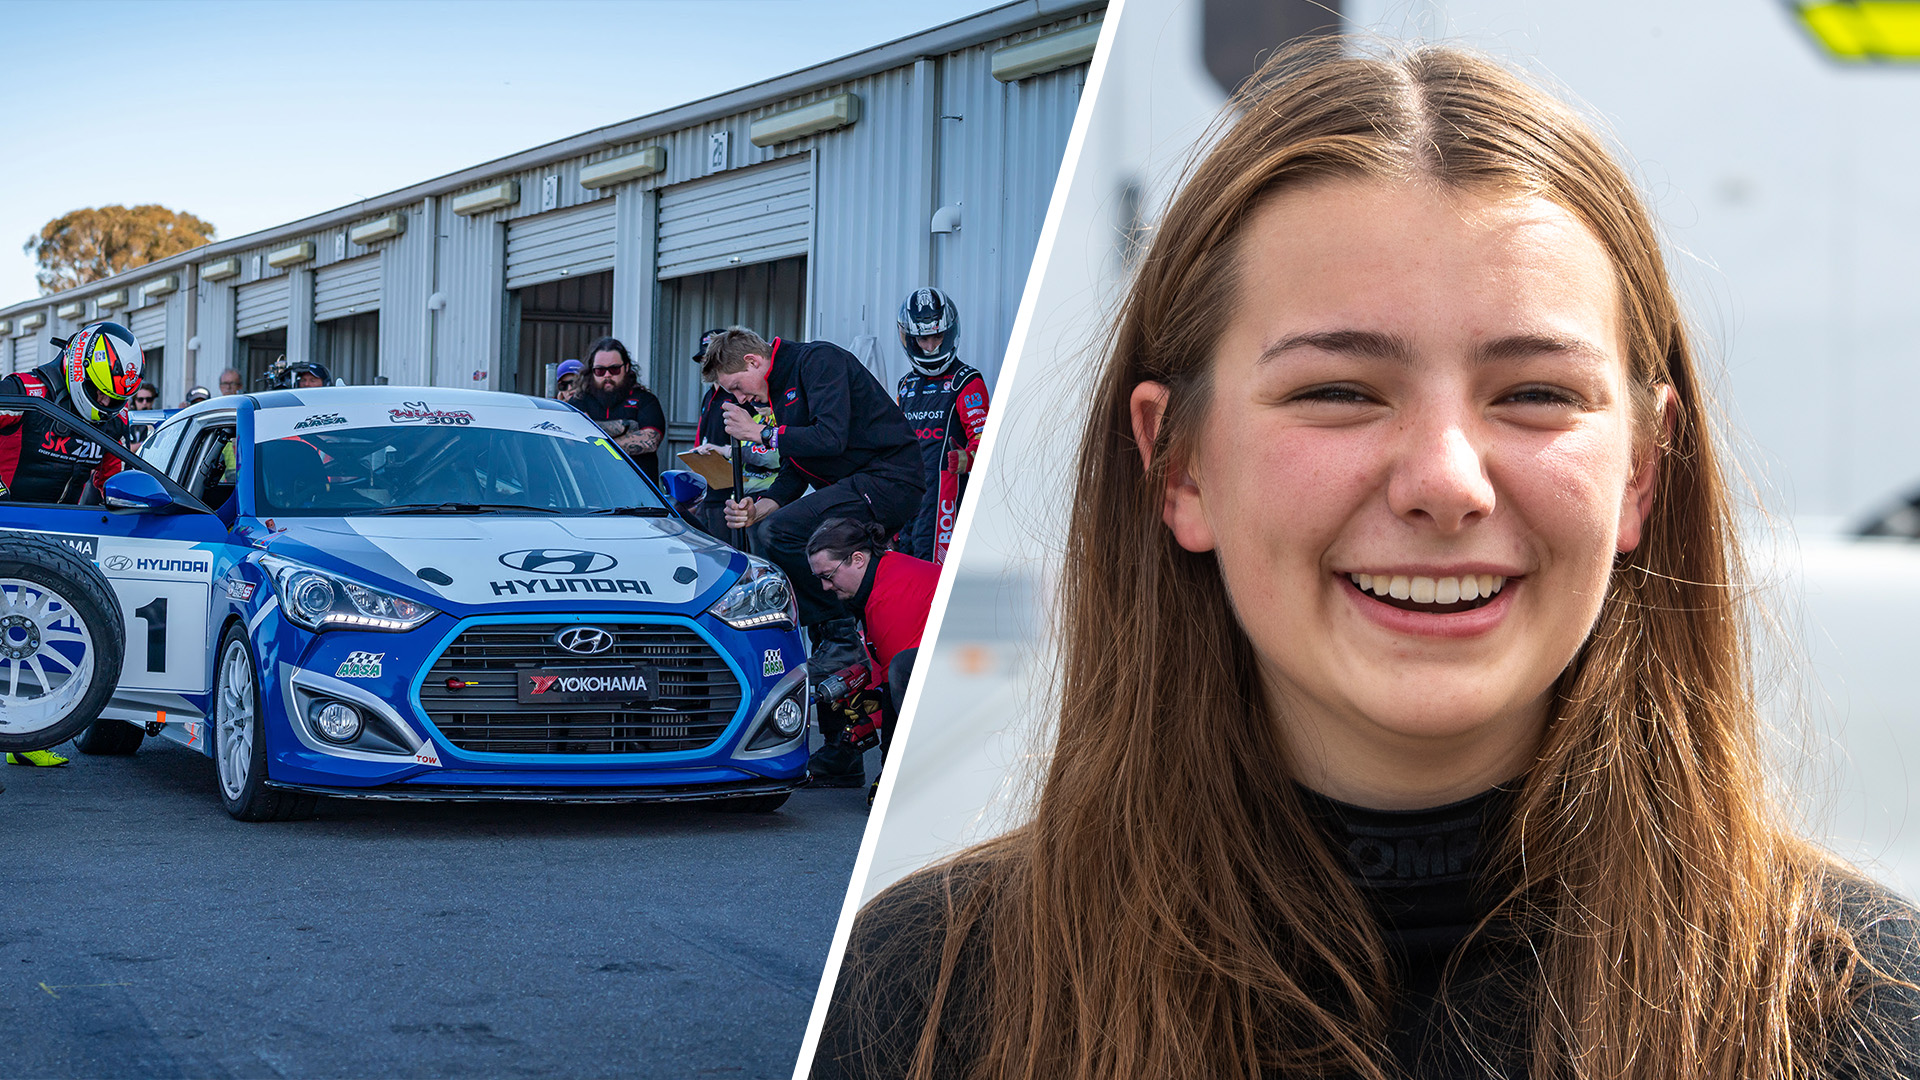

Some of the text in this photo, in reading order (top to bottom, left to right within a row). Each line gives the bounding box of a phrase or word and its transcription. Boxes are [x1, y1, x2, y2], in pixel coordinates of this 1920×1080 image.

[73, 341, 86, 382] PEDDERS
[426, 416, 471, 425] 300
[41, 431, 71, 455] SK
[593, 438, 622, 460] 1
[938, 499, 955, 544] BOC
[137, 558, 209, 573] HYUNDAI
[489, 576, 654, 598] HYUNDAI
[135, 597, 168, 673] 1
[339, 663, 381, 676] AASA
[764, 660, 784, 674] AASA
[557, 676, 648, 692] YOKOHAMA
[416, 755, 438, 764] TOW
